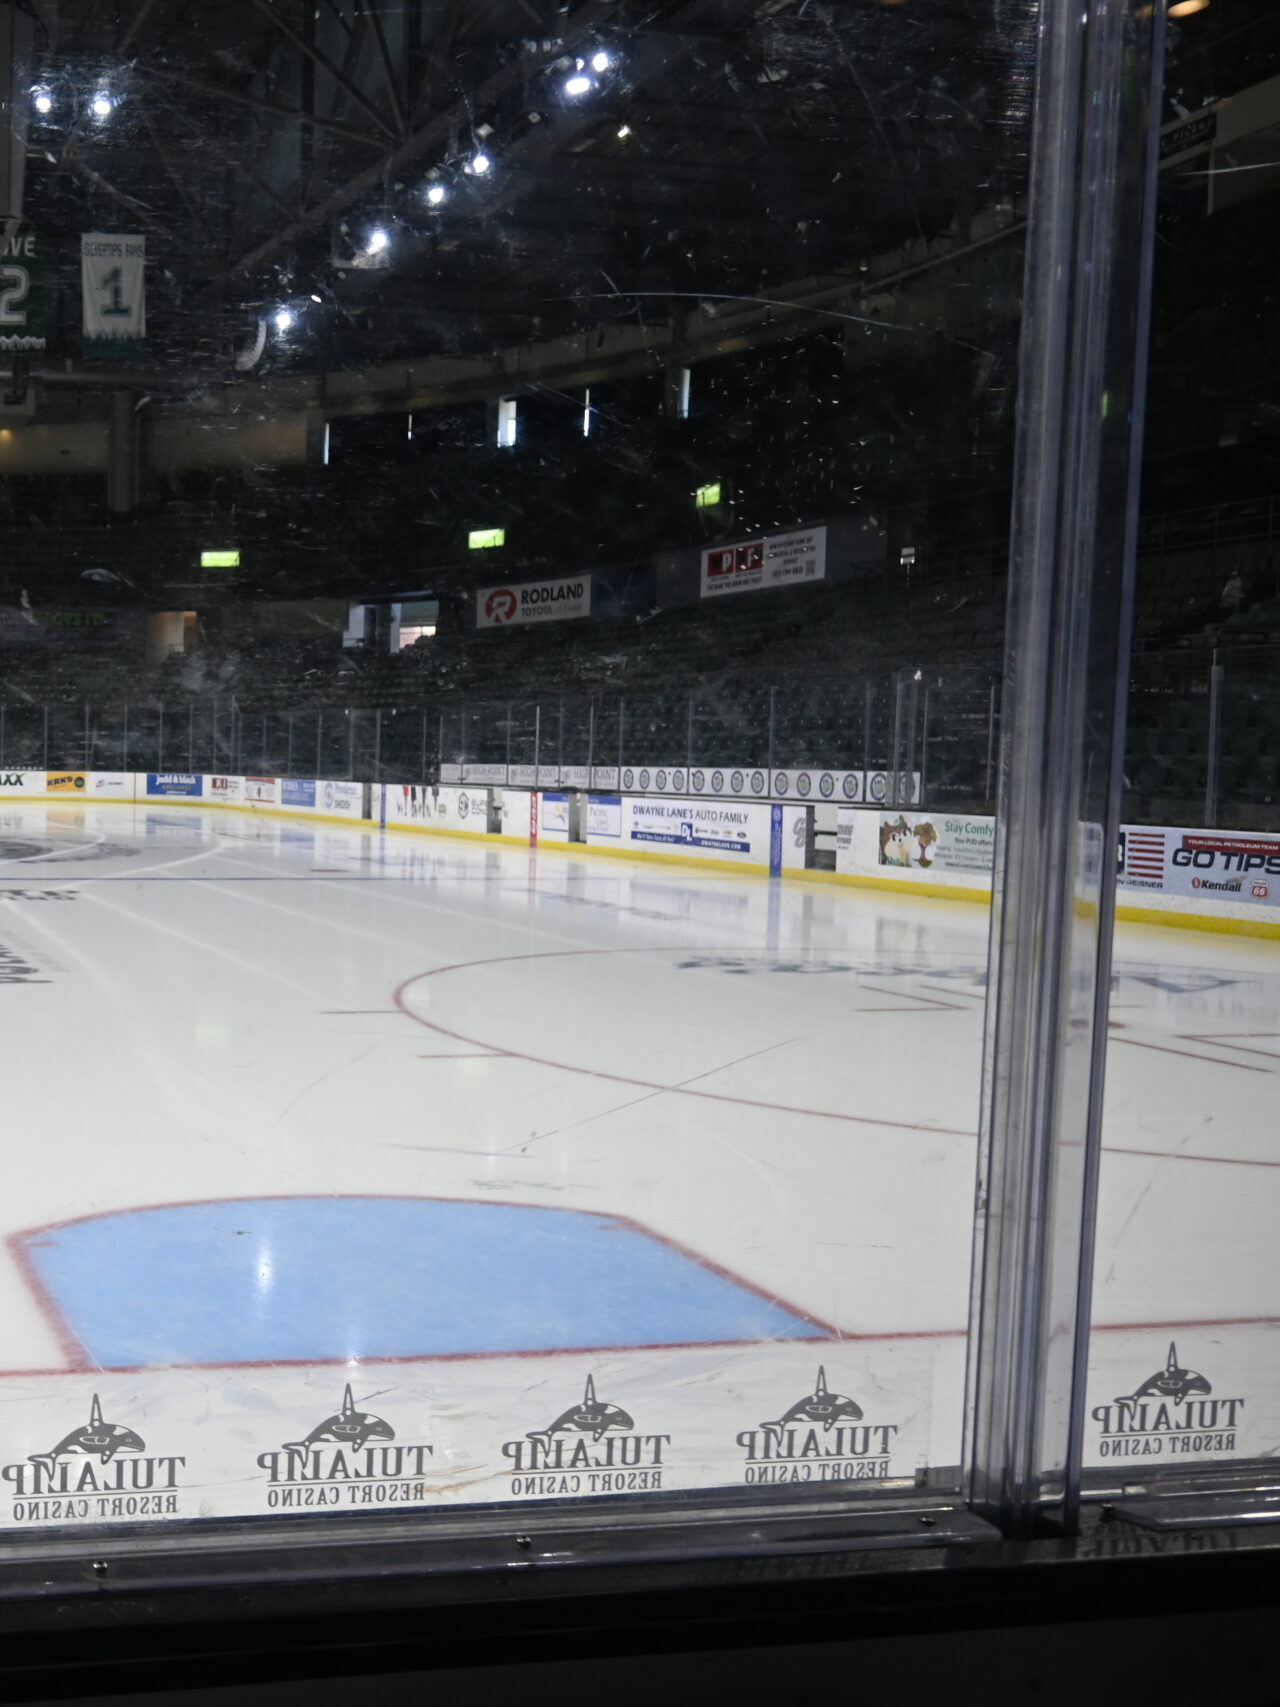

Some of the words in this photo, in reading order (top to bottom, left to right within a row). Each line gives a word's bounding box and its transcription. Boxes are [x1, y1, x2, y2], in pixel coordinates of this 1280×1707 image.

[100, 265, 133, 318] 1
[521, 583, 584, 605] RODLAND
[521, 606, 553, 617] TOYOTA
[632, 804, 665, 817] DWAYNE
[666, 807, 694, 819] LANE'S
[695, 809, 718, 822] AUTO
[719, 812, 749, 825] FAMILY
[944, 820, 964, 837] Stay
[964, 822, 994, 840] Comfy
[1223, 841, 1261, 849] PETROLEUM
[1172, 848, 1215, 868] GO
[1201, 879, 1242, 893] Kendall
[1253, 887, 1267, 896] 66
